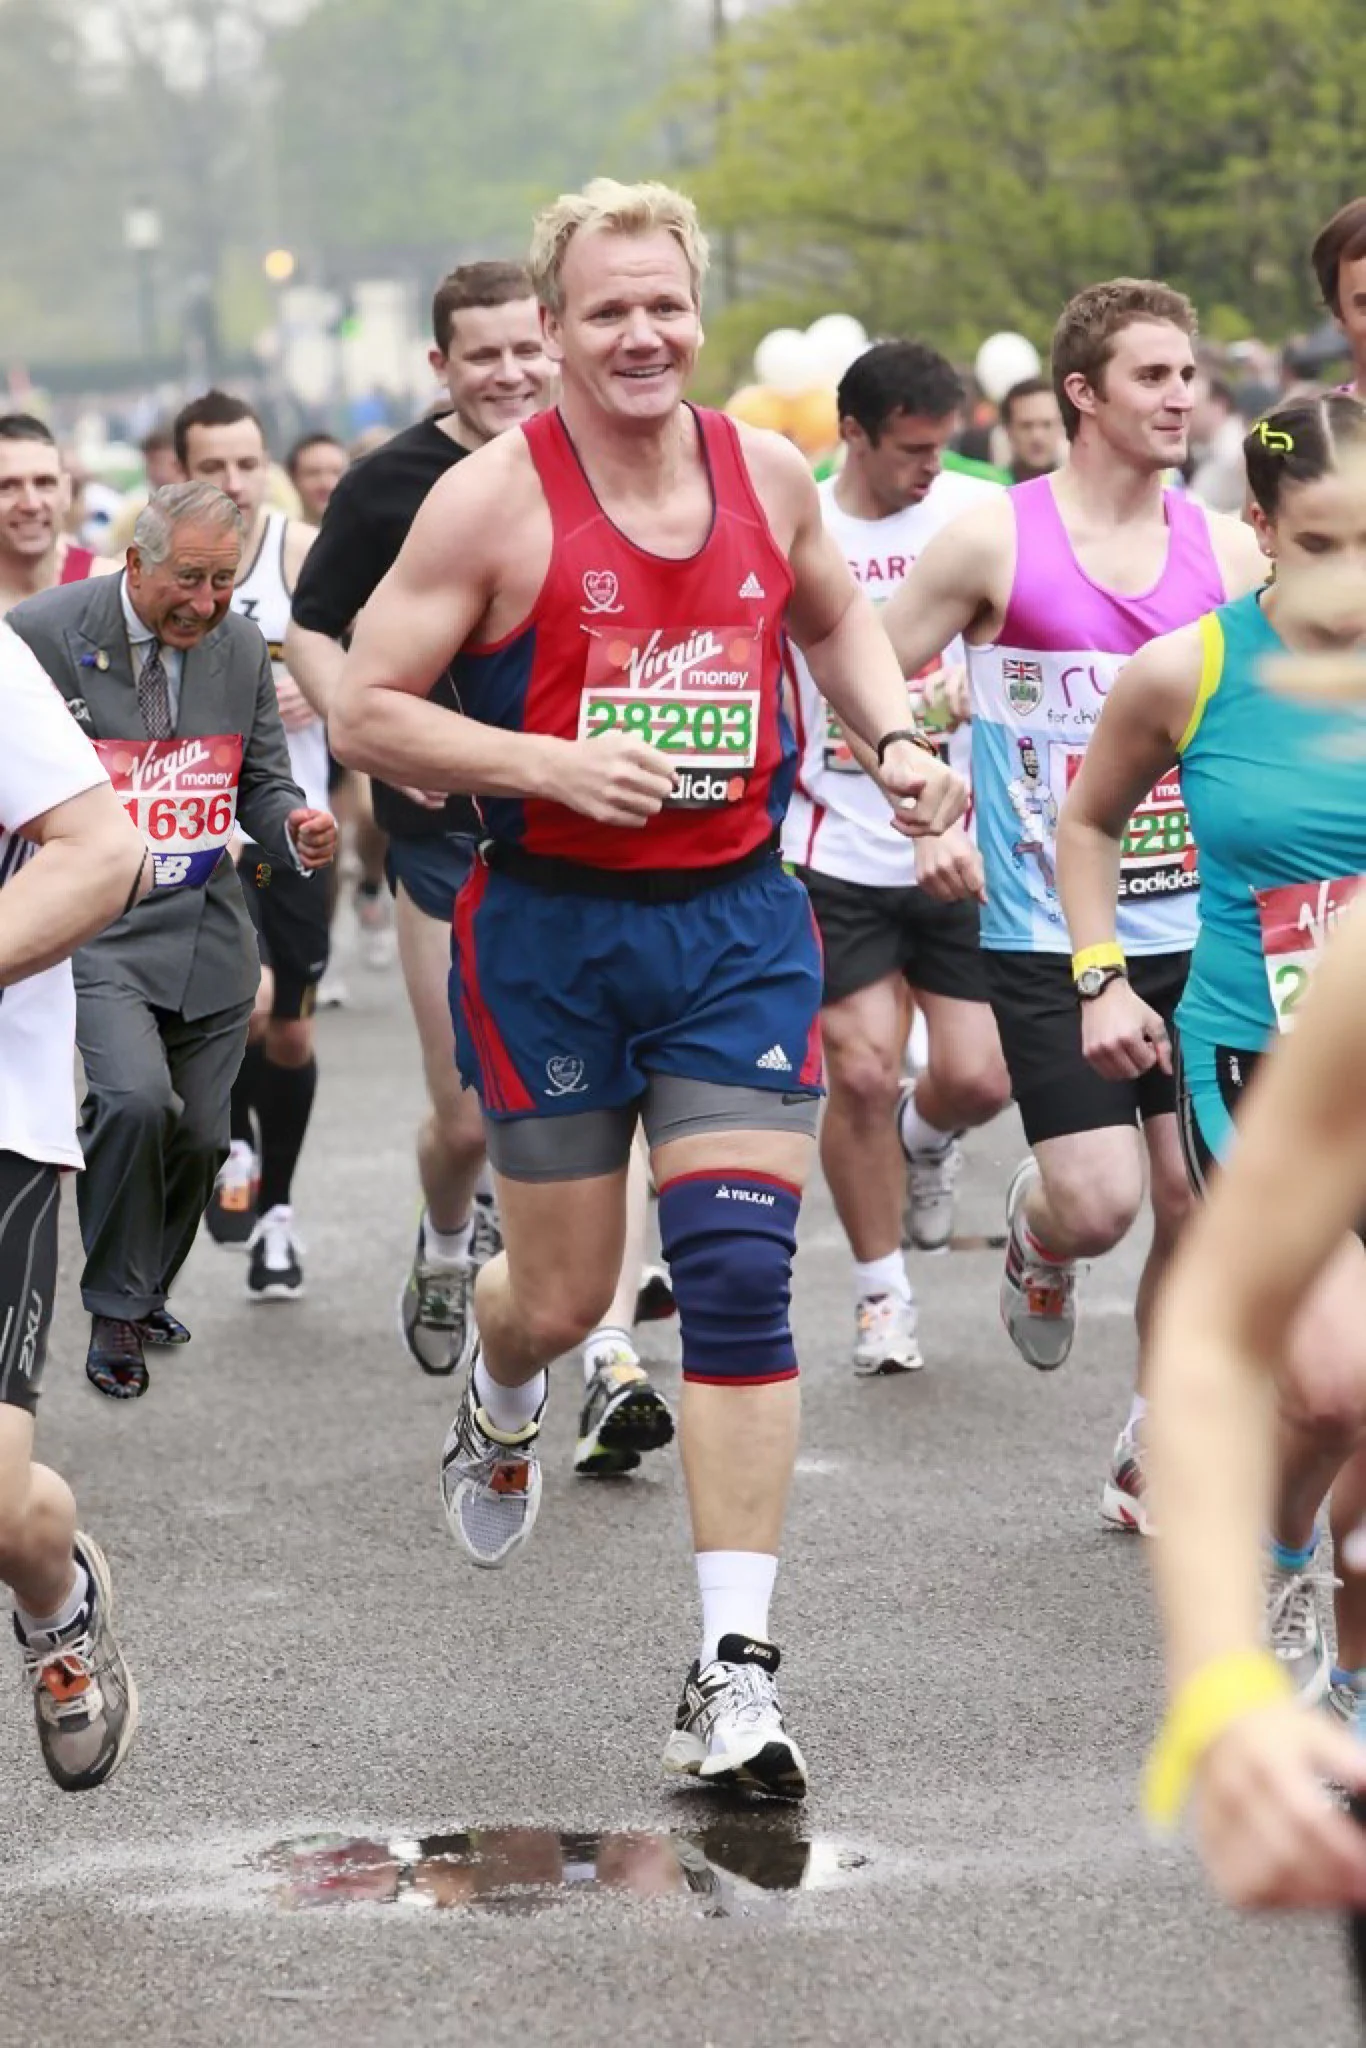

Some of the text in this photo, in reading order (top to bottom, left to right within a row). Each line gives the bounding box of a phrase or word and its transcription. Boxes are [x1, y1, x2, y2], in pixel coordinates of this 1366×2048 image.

[848, 555, 916, 581] GAR
[622, 629, 723, 691] Virgin
[689, 670, 749, 688] money
[586, 700, 752, 751] 28203
[125, 740, 210, 791] Virgin
[182, 772, 233, 787] money
[1156, 784, 1181, 797] mo
[123, 793, 232, 841] 1636
[1275, 964, 1309, 1016] 2
[18, 1289, 43, 1379] 2XU
